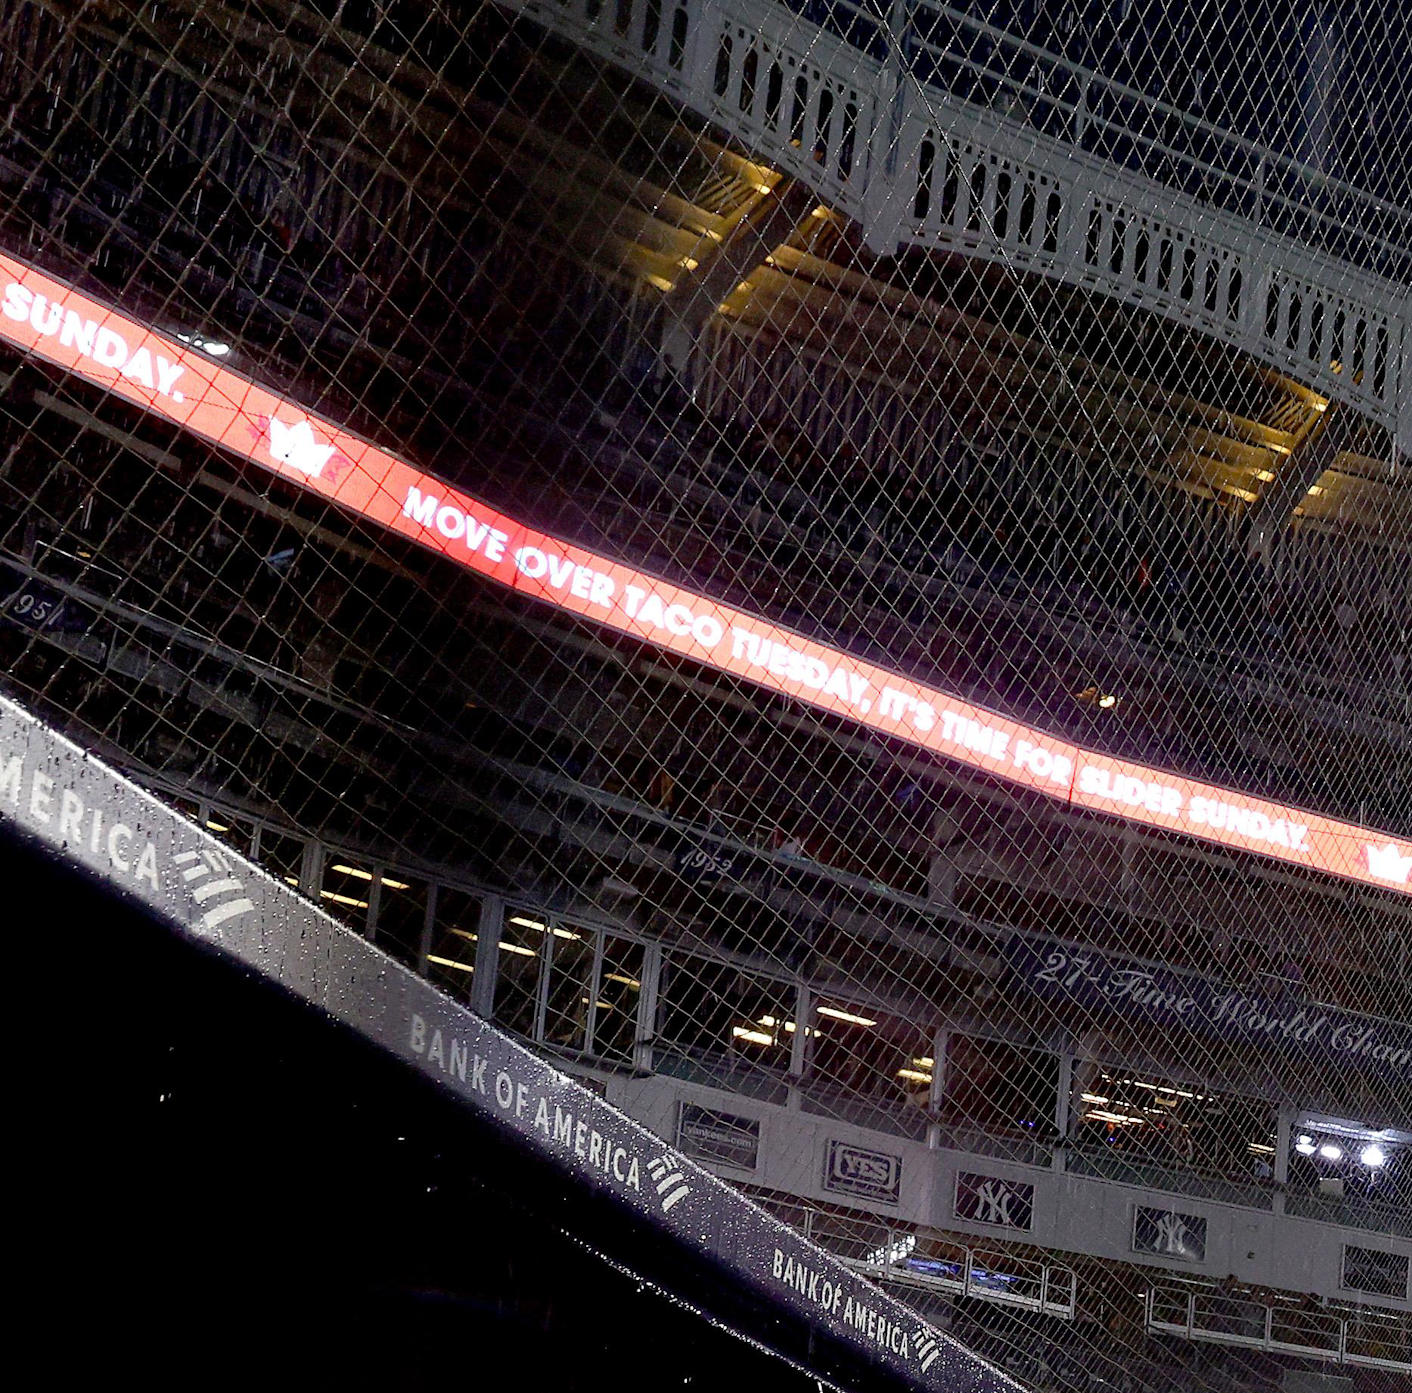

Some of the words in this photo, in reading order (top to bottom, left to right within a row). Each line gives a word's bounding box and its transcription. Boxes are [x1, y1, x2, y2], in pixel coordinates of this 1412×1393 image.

[1, 281, 185, 403] SUNDAY.
[402, 486, 508, 562] MOVE
[515, 546, 615, 608] OVER
[624, 584, 722, 648] TACO
[731, 627, 870, 713] TUESDAY,
[879, 686, 934, 731] IT'S
[941, 710, 1010, 761] TIME
[1014, 740, 1073, 786] FOR
[1080, 766, 1183, 815] SLIDER
[1190, 796, 1309, 851] SUNDAY.
[0, 754, 160, 892] MERICA
[1210, 989, 1331, 1043] World
[409, 1014, 488, 1095] BANK
[496, 1071, 529, 1117] OF
[534, 1097, 641, 1192] AMERICA
[773, 1248, 820, 1302] BANK
[822, 1281, 842, 1315] OF
[843, 1297, 910, 1360] AMERICA
